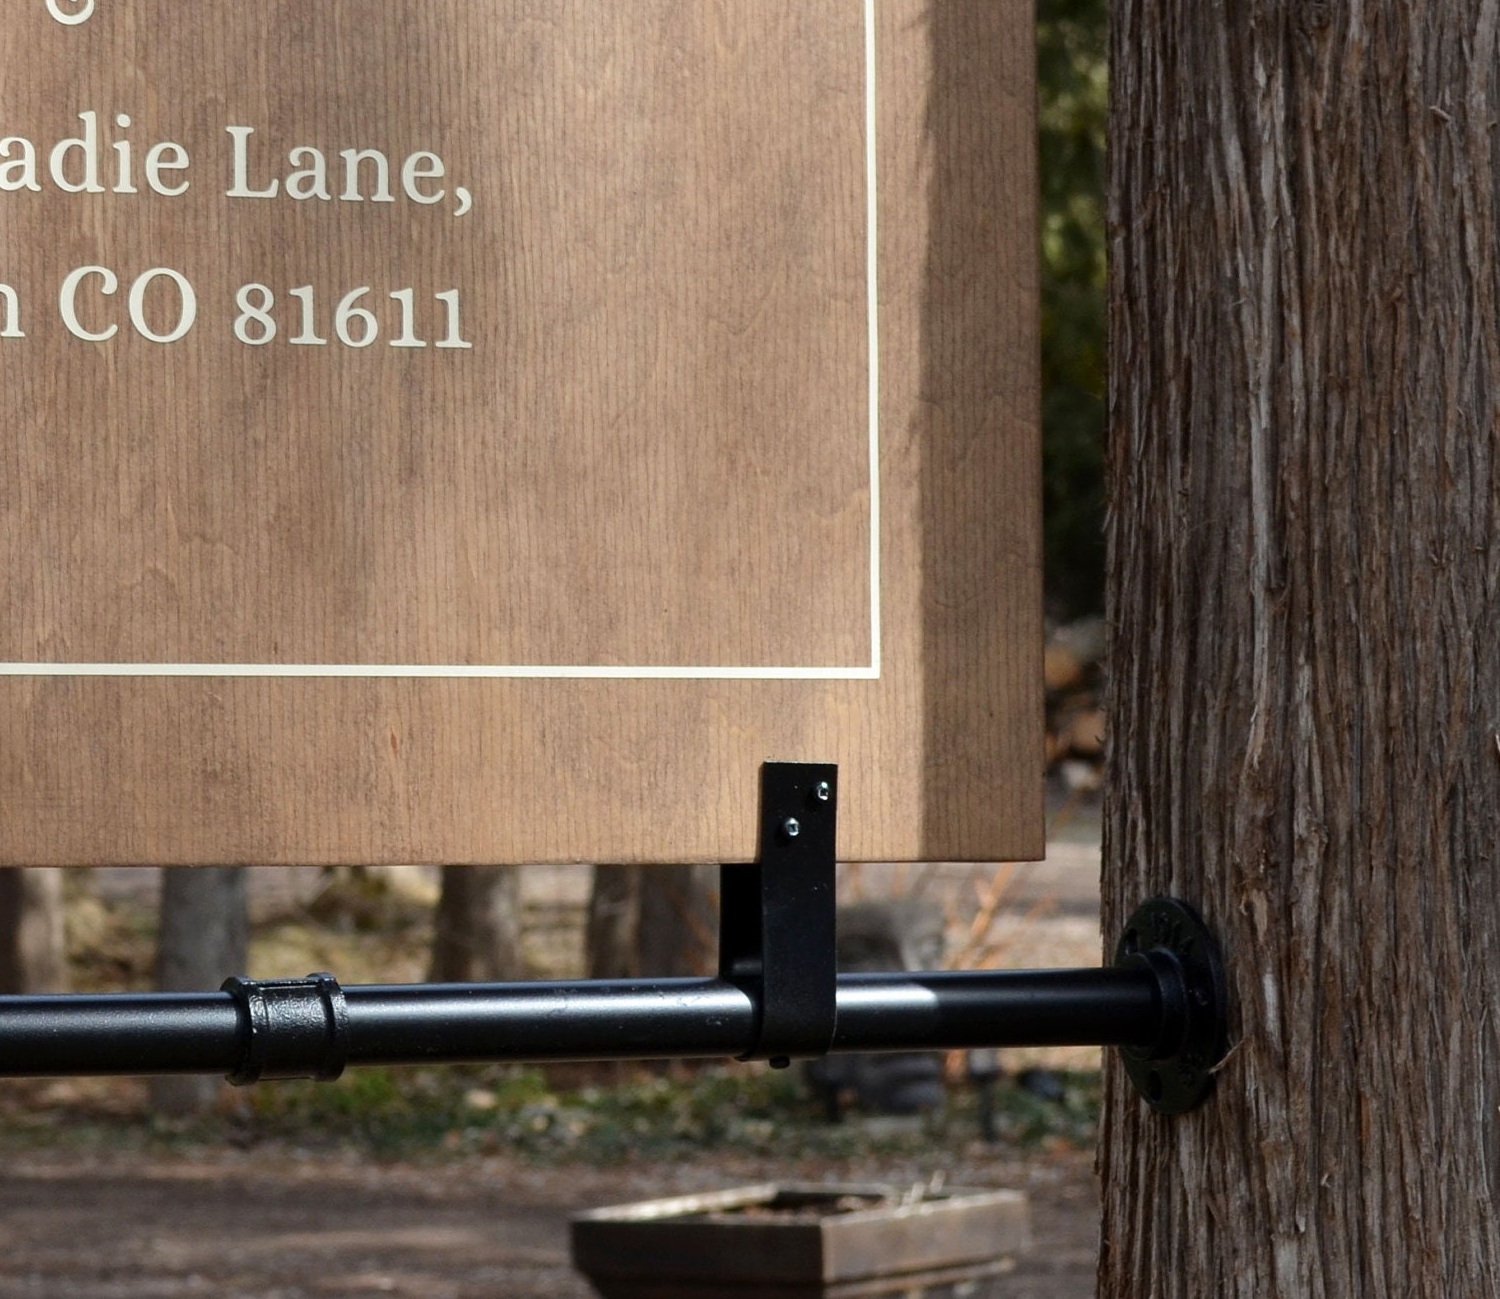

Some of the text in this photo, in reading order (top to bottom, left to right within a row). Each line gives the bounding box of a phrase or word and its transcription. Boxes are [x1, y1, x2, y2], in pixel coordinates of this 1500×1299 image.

[225, 124, 473, 218] Lane,
[58, 264, 198, 344] CO
[232, 282, 474, 350] 81611
